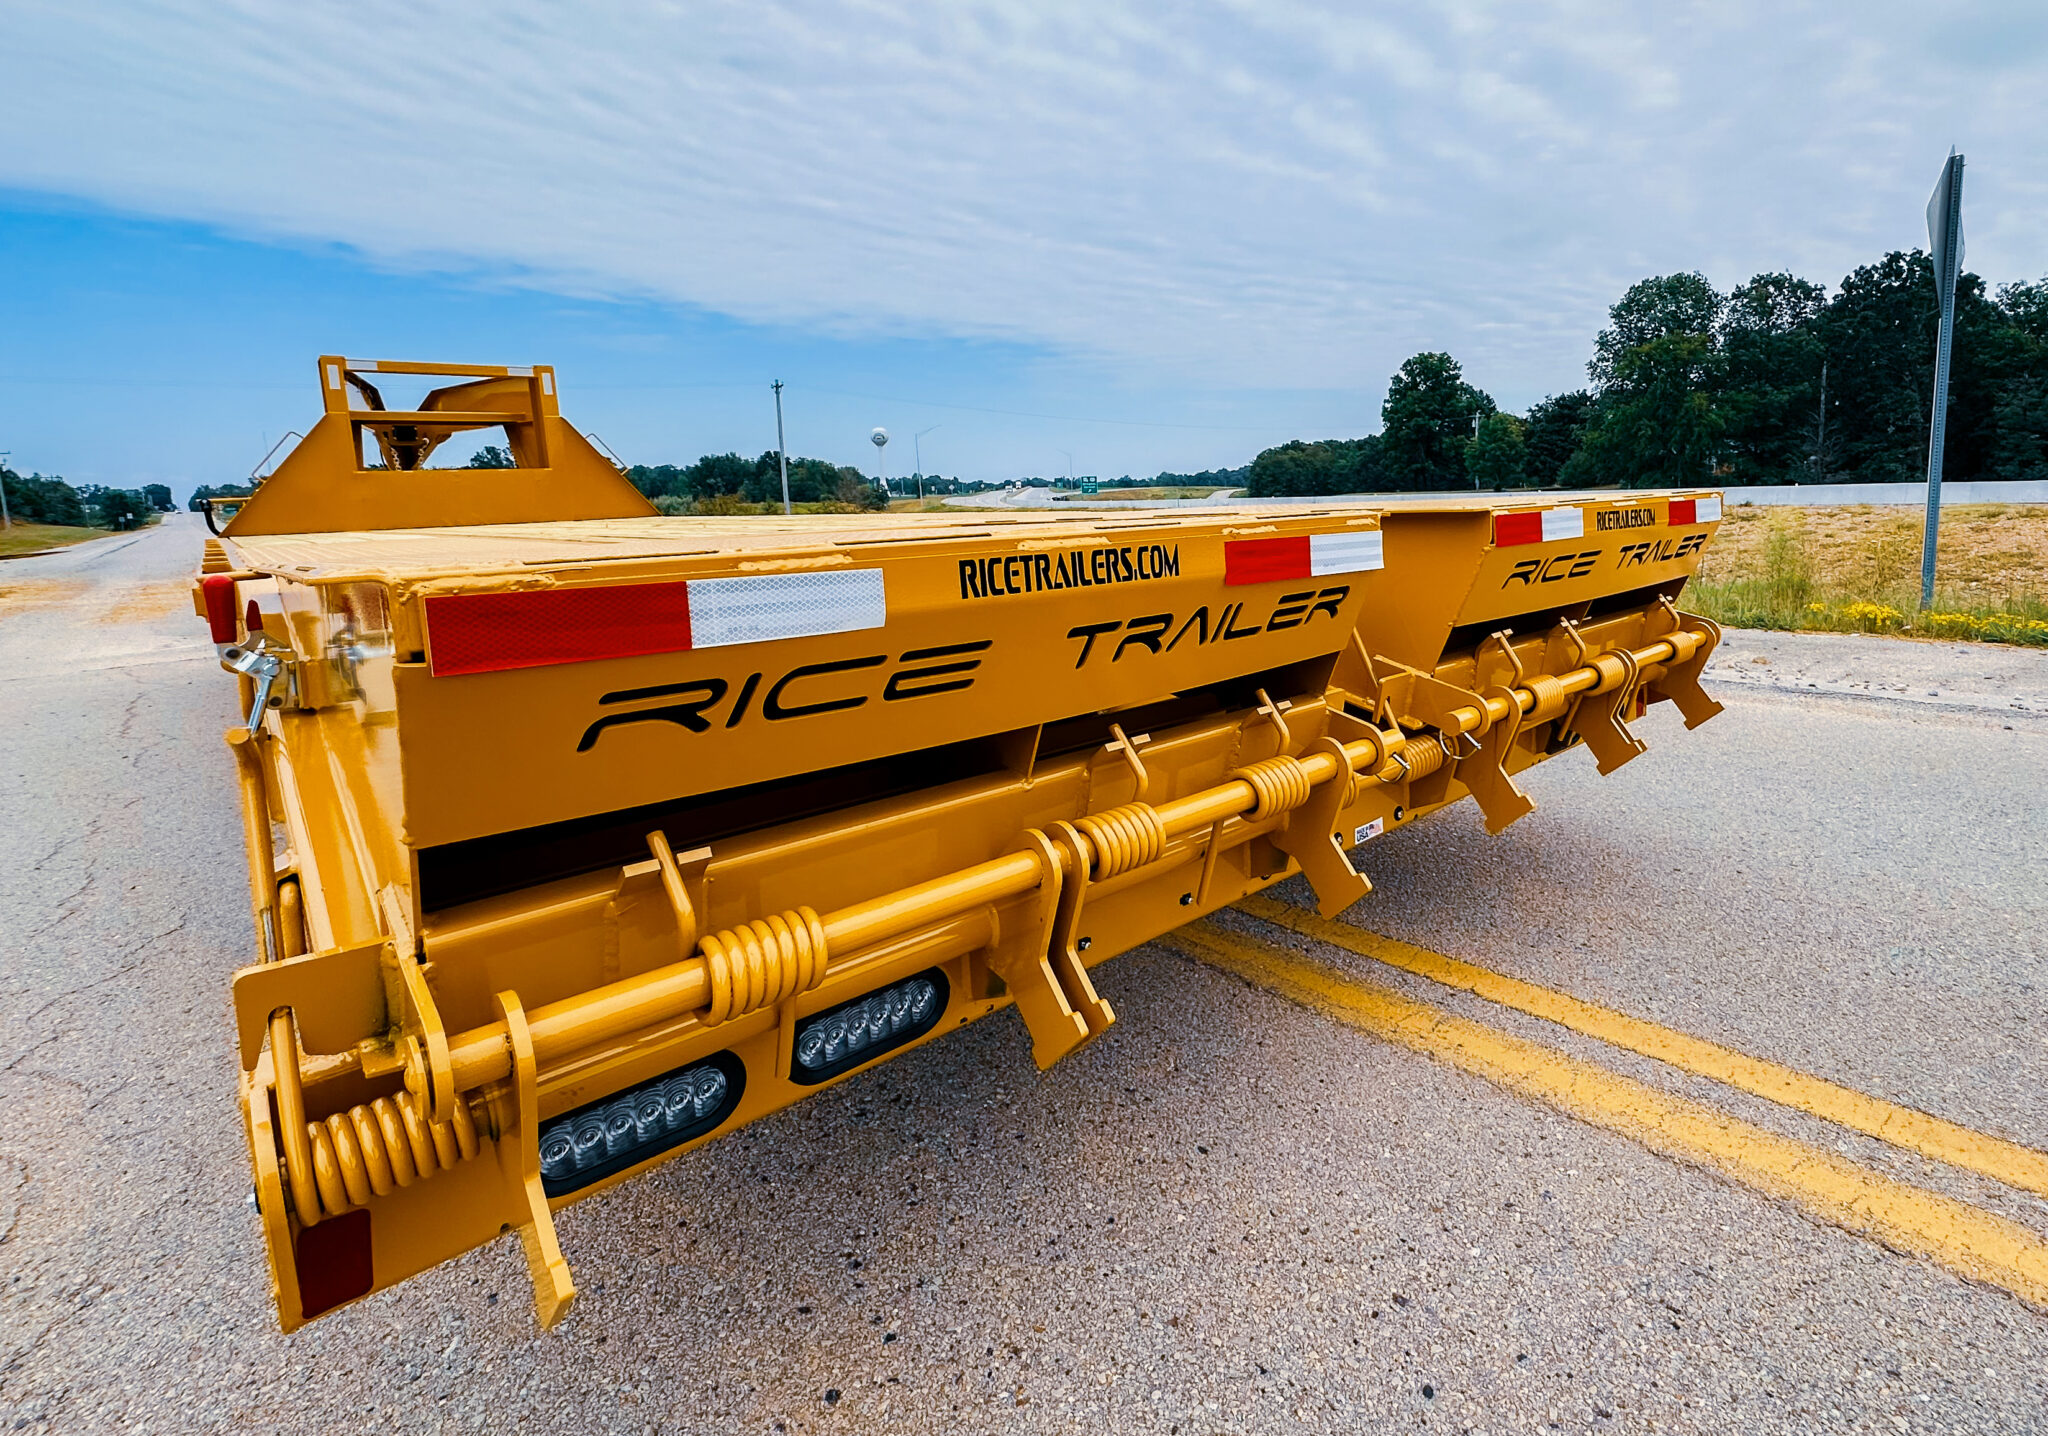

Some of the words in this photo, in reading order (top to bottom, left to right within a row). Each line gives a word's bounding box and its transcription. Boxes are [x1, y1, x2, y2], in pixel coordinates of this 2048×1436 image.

[1596, 508, 1656, 531] RICETRAILERS.COM
[958, 543, 1180, 600] RICETRAILERS.COM
[1501, 549, 1603, 590] RICE
[1616, 533, 1708, 570] TRAILER
[576, 638, 994, 754] RICE
[1066, 584, 1352, 671] TRAILER
